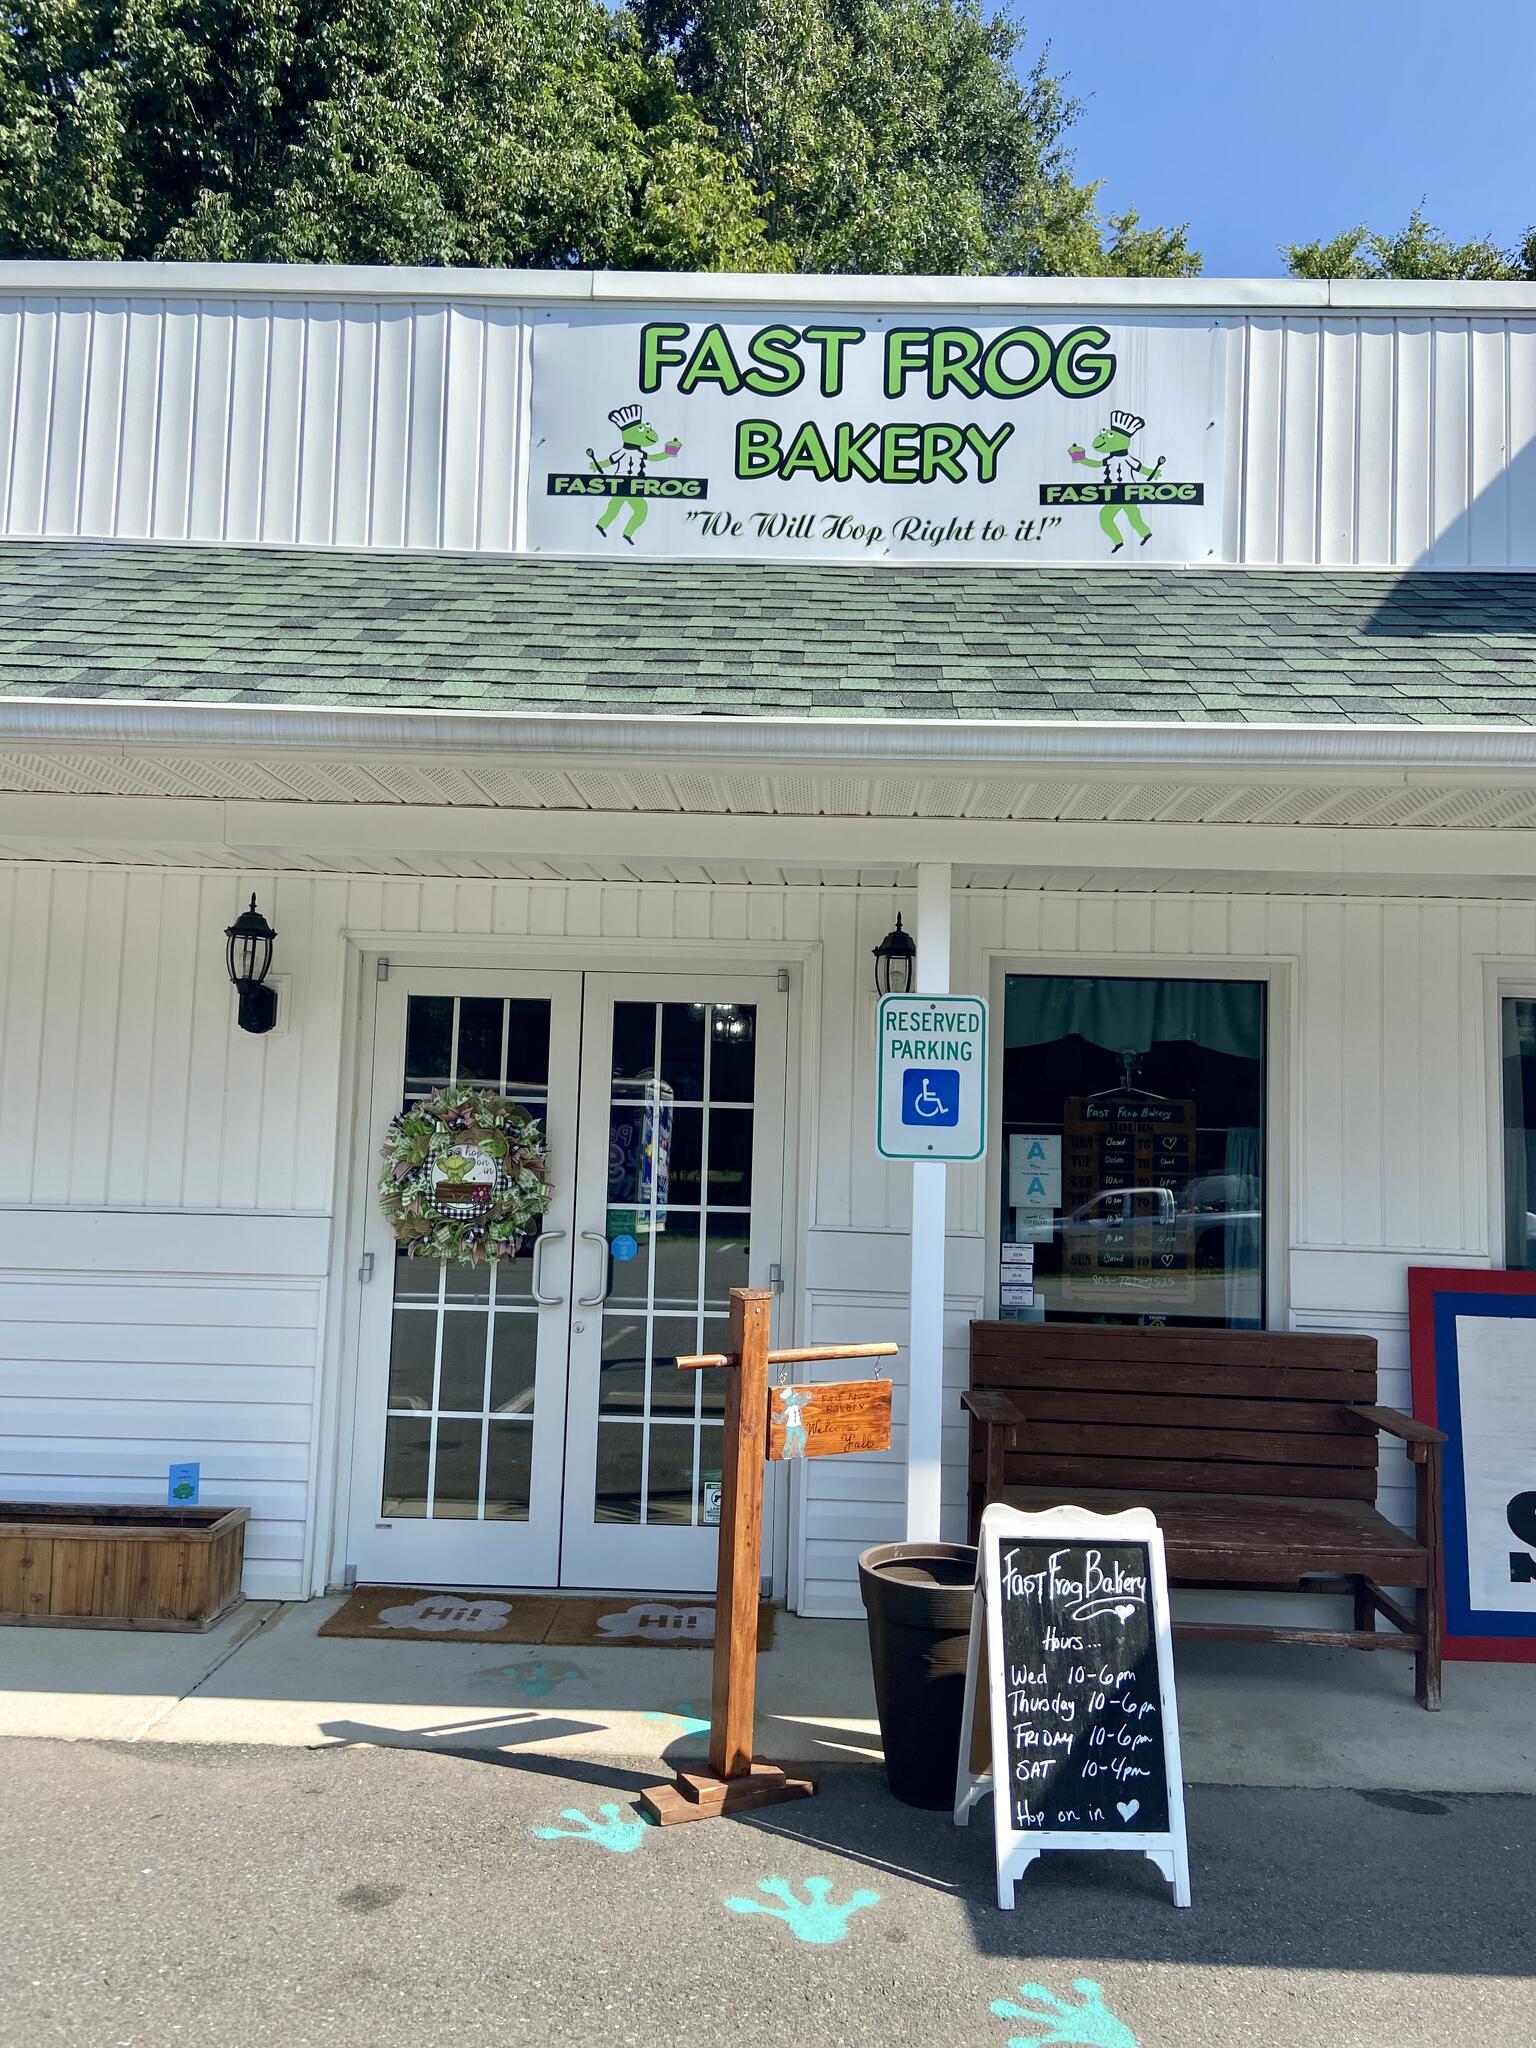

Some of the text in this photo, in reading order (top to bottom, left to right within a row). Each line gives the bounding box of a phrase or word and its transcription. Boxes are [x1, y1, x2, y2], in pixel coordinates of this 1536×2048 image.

[639, 321, 1117, 399] FAST FROG
[734, 418, 1016, 485] BAKERY
[554, 477, 702, 497] FAST FROG
[1046, 483, 1197, 503] FAST FROG
[750, 512, 815, 540] Will
[820, 514, 885, 546] Hop
[892, 515, 976, 546] Right
[981, 519, 1008, 542] to
[885, 1011, 980, 1033] RESERVED
[891, 1039, 972, 1062] PARKING
[1027, 1141, 1046, 1160] A
[1027, 1176, 1046, 1196] A
[419, 1606, 482, 1623] Hi!
[638, 1614, 698, 1630] Hi!
[1011, 1664, 1048, 1686] Wed
[1007, 1690, 1075, 1721] Thursday
[1016, 1759, 1056, 1780] SAT
[1017, 1799, 1105, 1827] Hop on in
